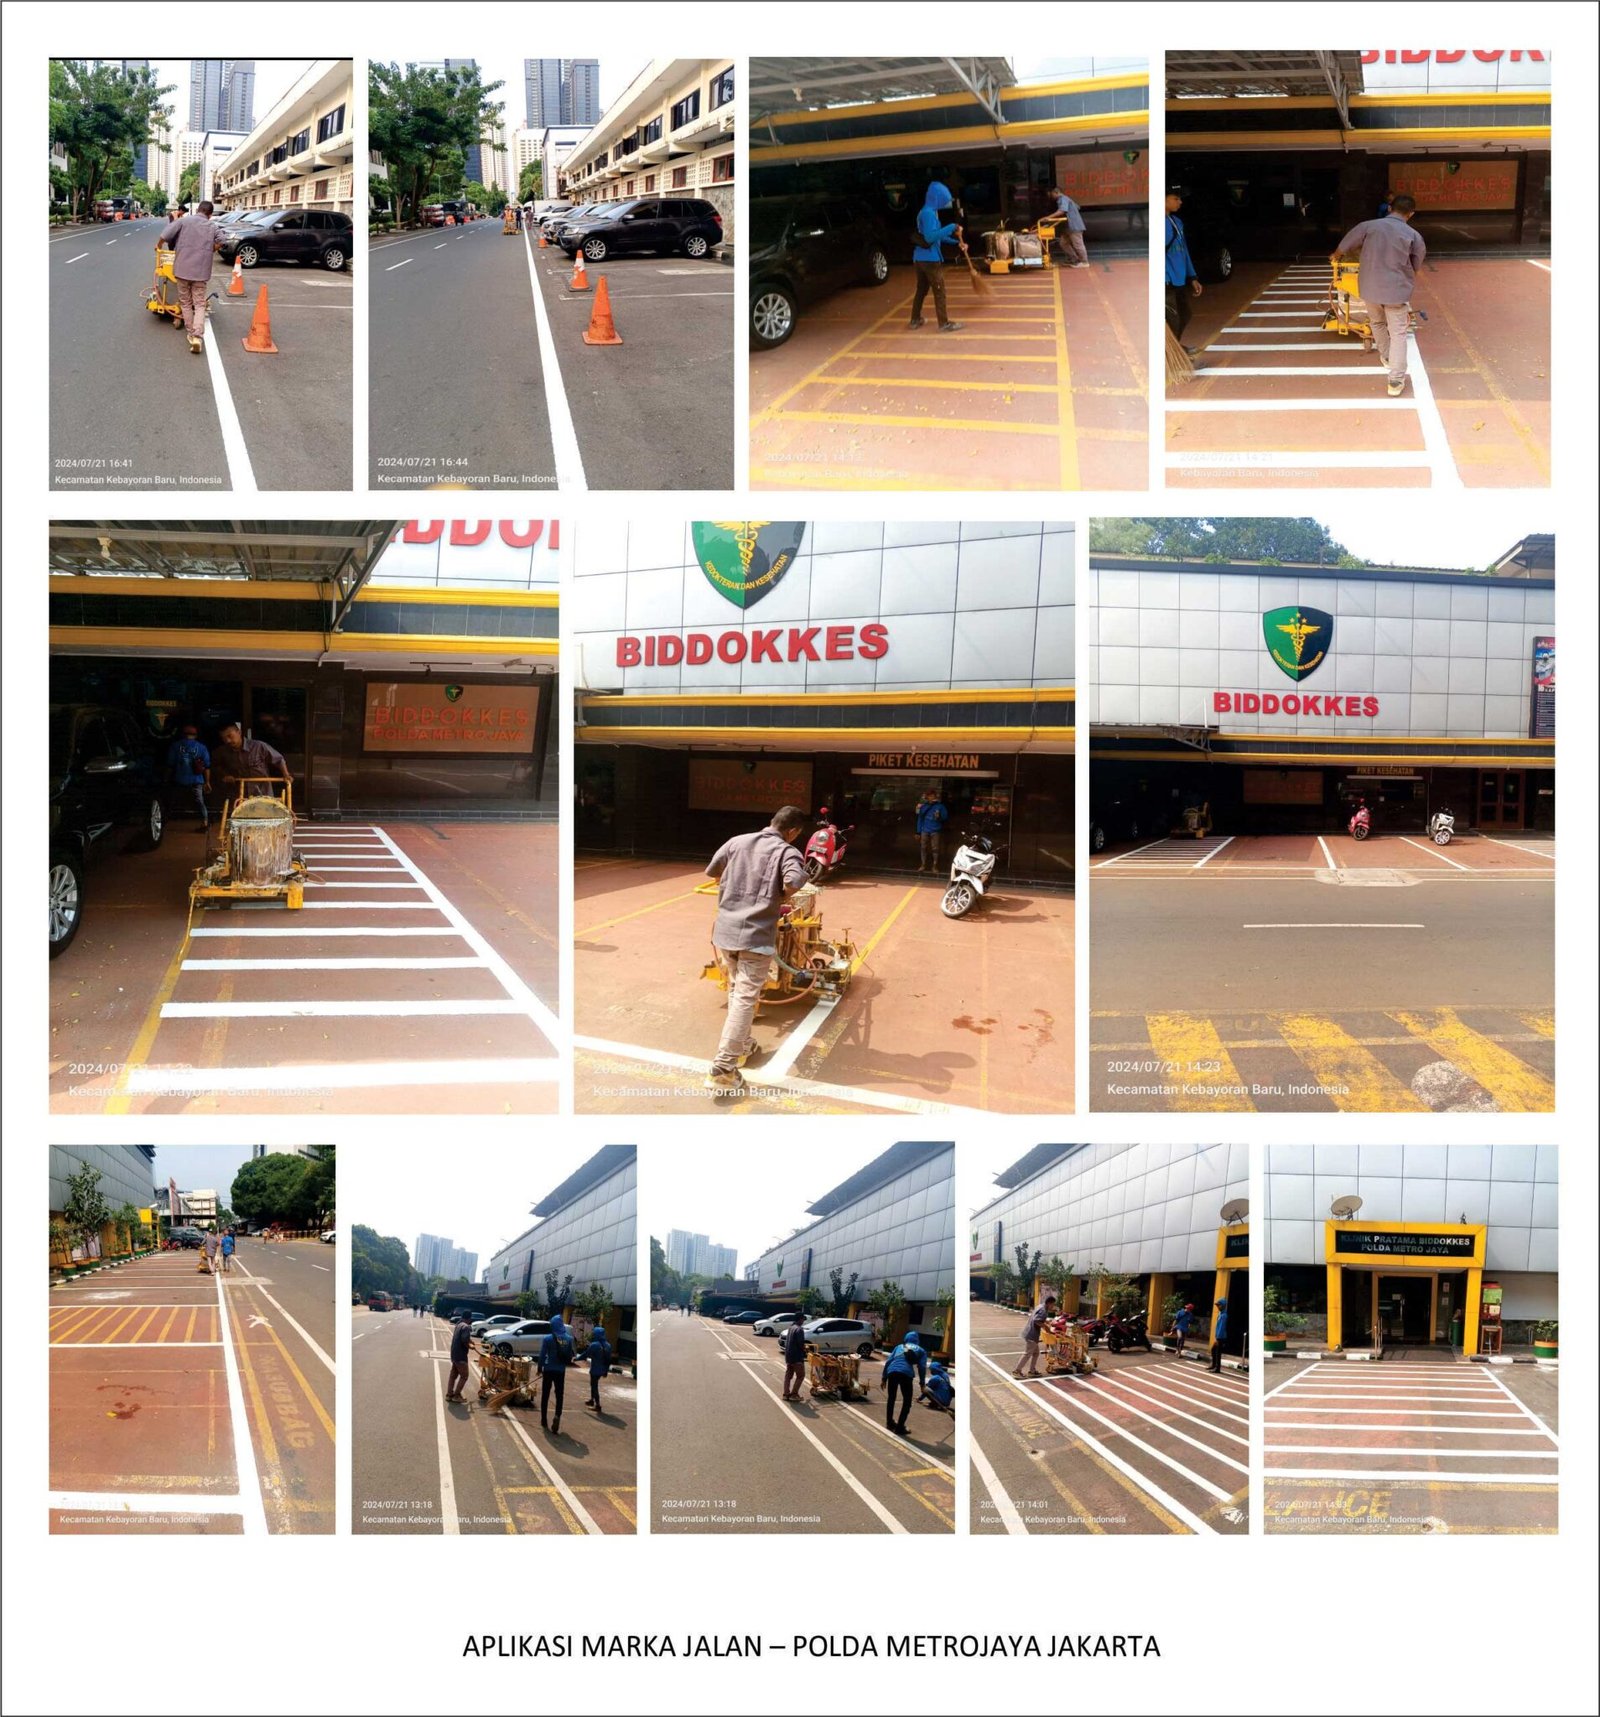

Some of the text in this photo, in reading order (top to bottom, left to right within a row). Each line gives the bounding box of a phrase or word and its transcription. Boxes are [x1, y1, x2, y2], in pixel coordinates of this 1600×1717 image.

[705, 554, 788, 590] KEDOKTERAN DAN KESEHATAN
[616, 623, 889, 667] BIDDOKKES
[1213, 691, 1379, 717] BIDDOKKES
[374, 706, 529, 727] BIDDOKKES
[372, 728, 429, 741] POLDA
[868, 754, 979, 769] PIKET KESEHATAN
[1341, 1234, 1470, 1246] KLINIK PRATAMA BIDDOKKES
[1361, 1244, 1449, 1254] POLDA METRO JAYA
